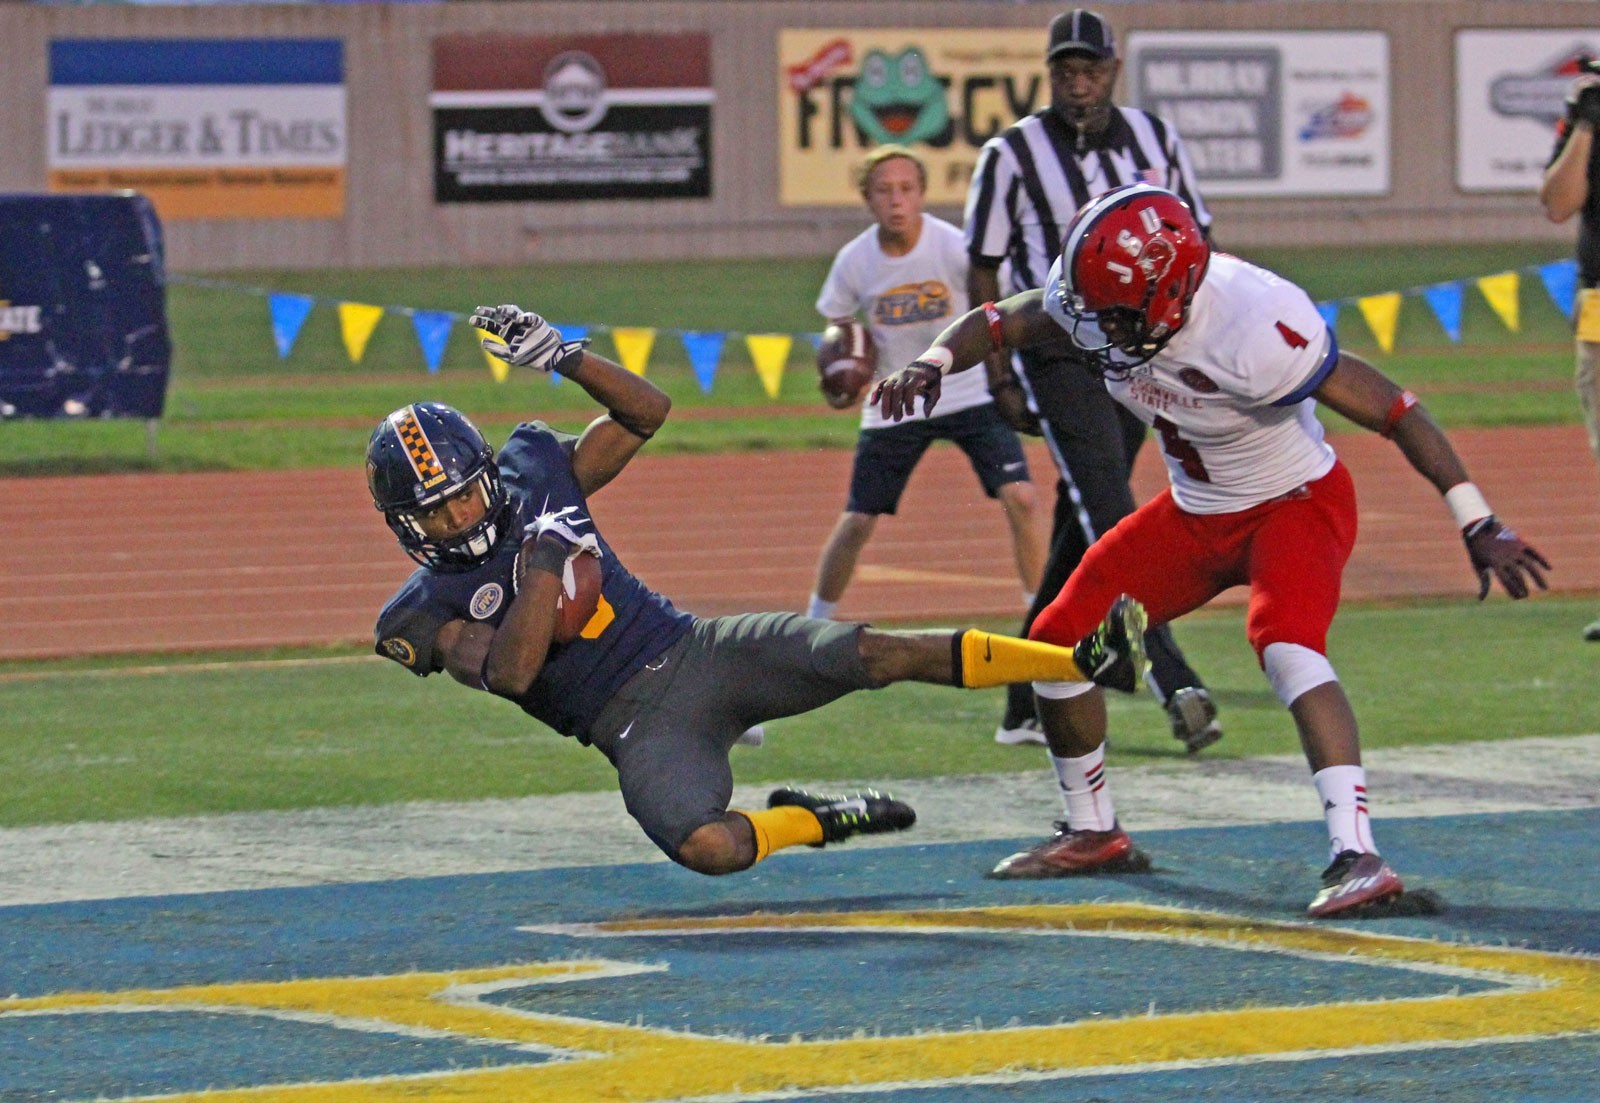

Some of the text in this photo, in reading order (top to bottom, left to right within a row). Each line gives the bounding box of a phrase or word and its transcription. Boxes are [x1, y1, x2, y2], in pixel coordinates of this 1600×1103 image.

[58, 109, 339, 156] LEDGER & TIMES
[1106, 205, 1162, 284] JSU
[1275, 320, 1309, 350] 4
